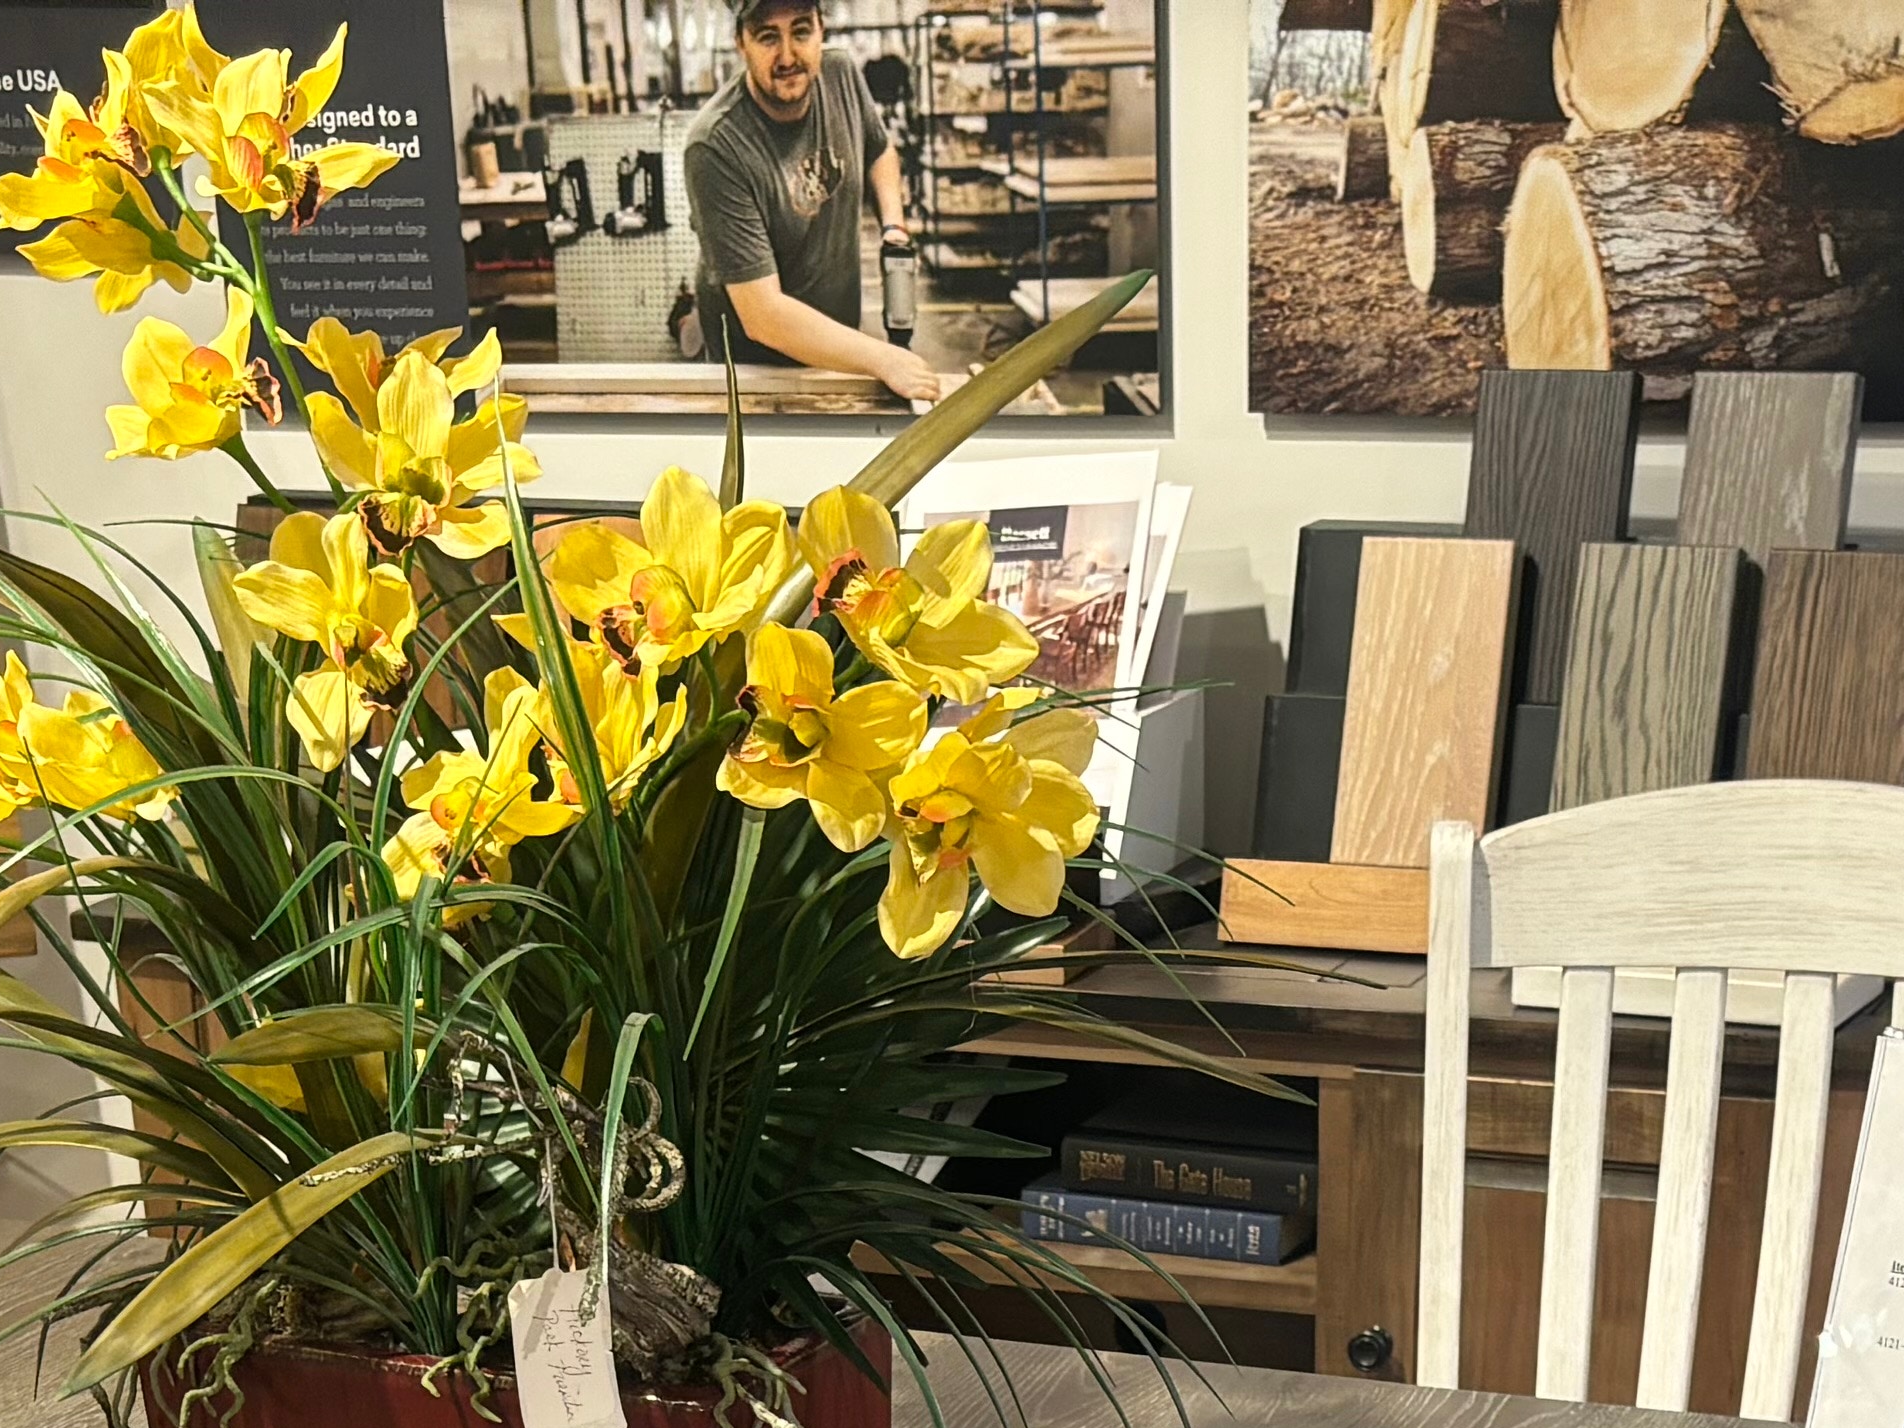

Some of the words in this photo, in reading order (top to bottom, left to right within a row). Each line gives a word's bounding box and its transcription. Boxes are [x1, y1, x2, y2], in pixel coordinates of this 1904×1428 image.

[17, 70, 63, 92] USA
[306, 103, 374, 134] signed
[378, 105, 401, 128] to
[405, 109, 418, 126] a
[1153, 1160, 1175, 1190] The
